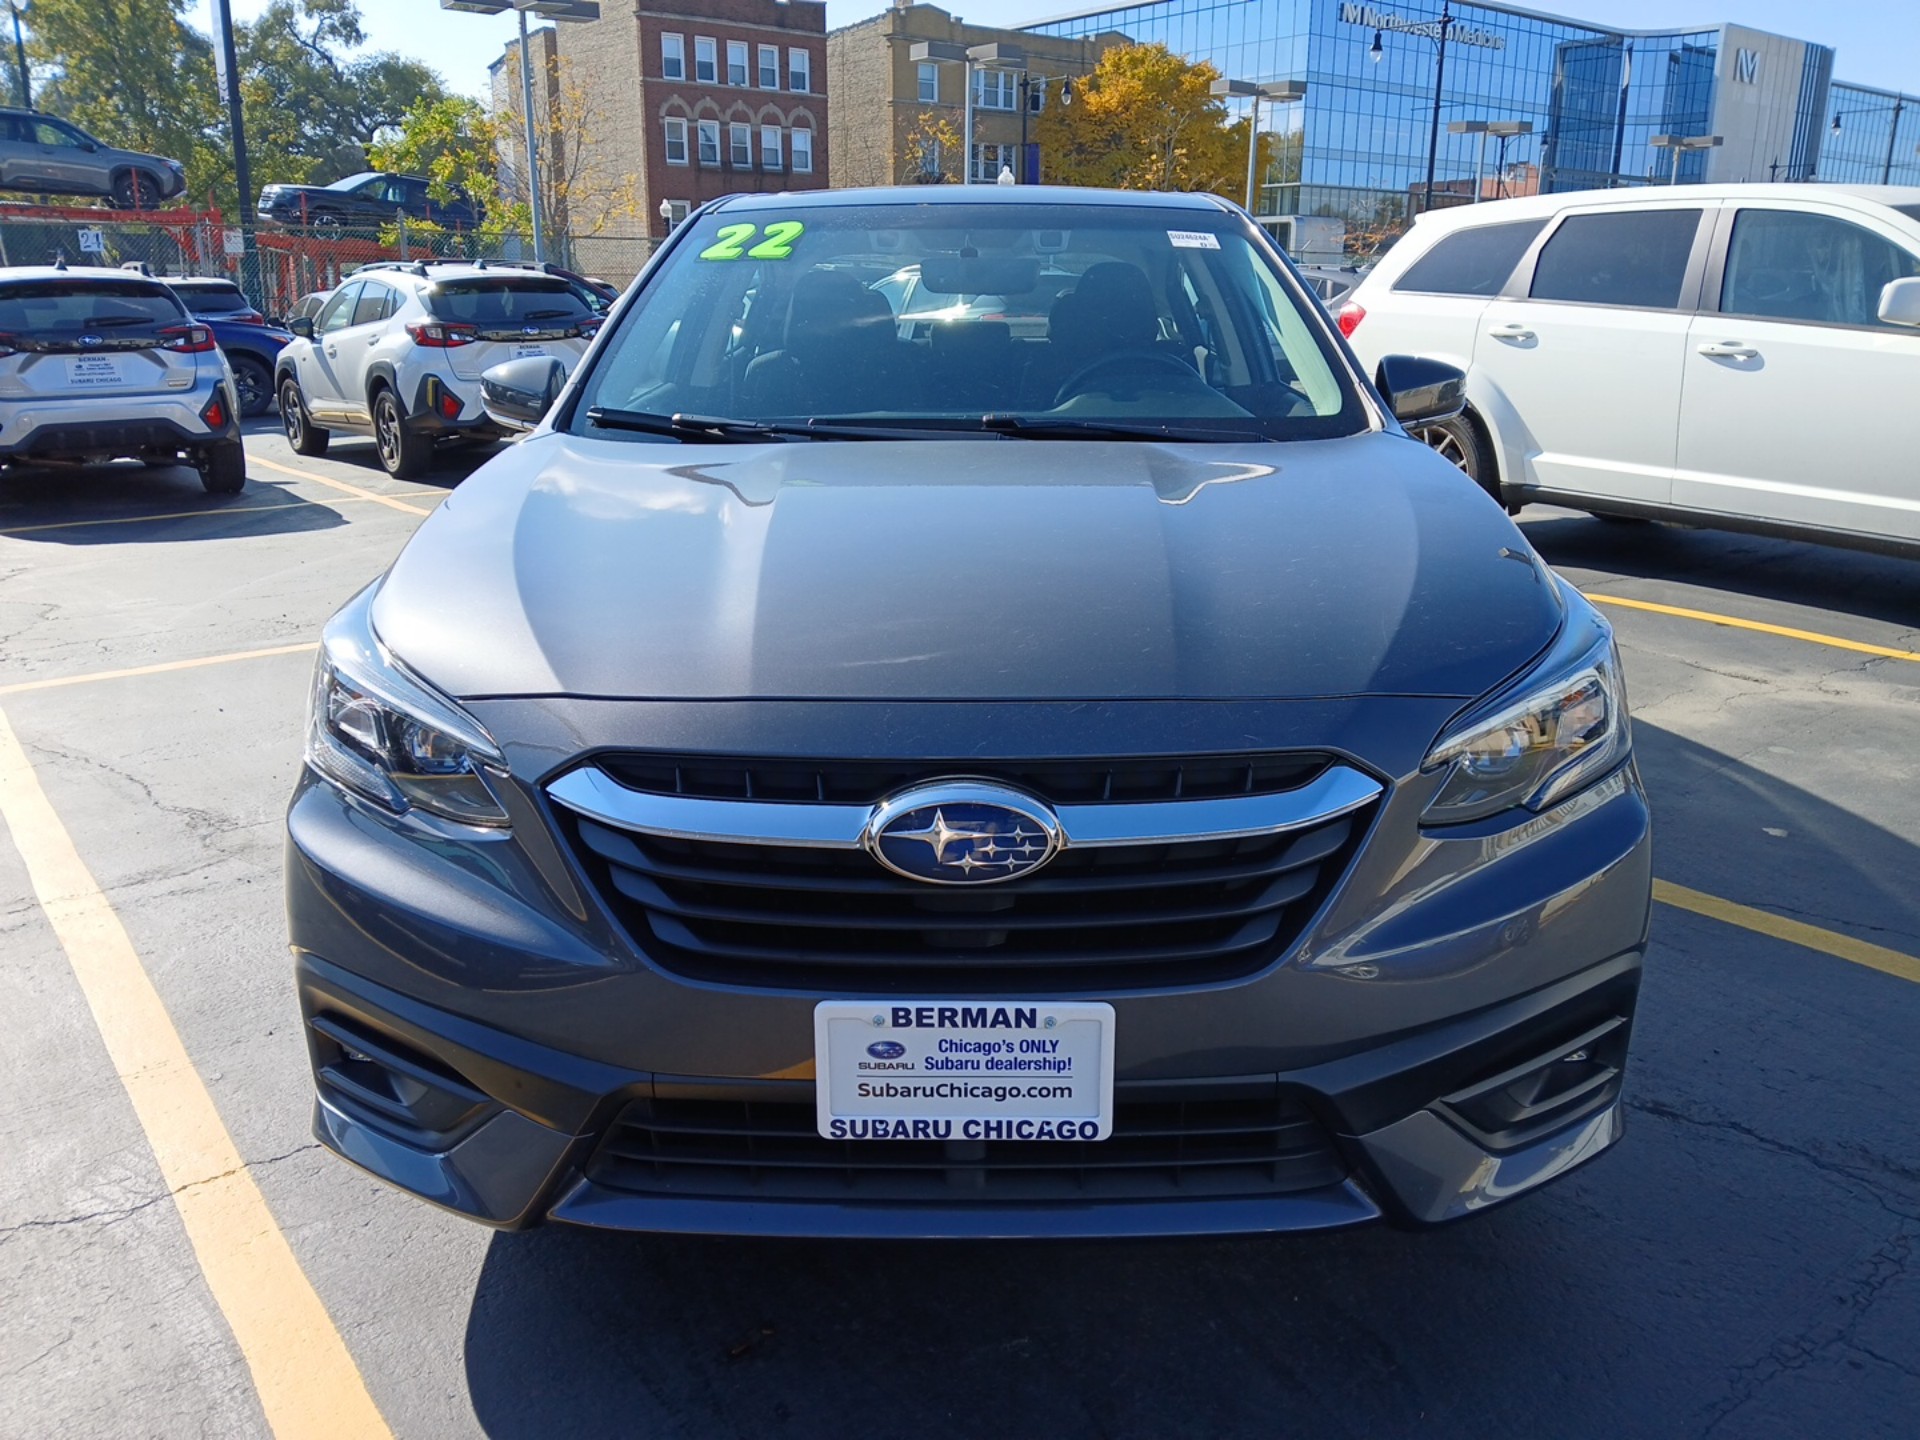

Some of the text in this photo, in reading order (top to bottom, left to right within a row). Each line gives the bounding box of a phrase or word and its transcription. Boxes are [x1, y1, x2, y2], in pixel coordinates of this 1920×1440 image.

[1363, 6, 1454, 41] Northwesten
[1454, 24, 1506, 49] Medicine
[700, 221, 805, 260] 22
[891, 1006, 1037, 1029] BERMAN
[938, 1039, 1059, 1055] Chicago's ONLY
[858, 1062, 915, 1070] SUBARU
[924, 1056, 1072, 1073] Subaru dealership!
[857, 1082, 1073, 1102] SubaruChicago.com
[829, 1118, 1099, 1140] SUBARU CHICAGO
